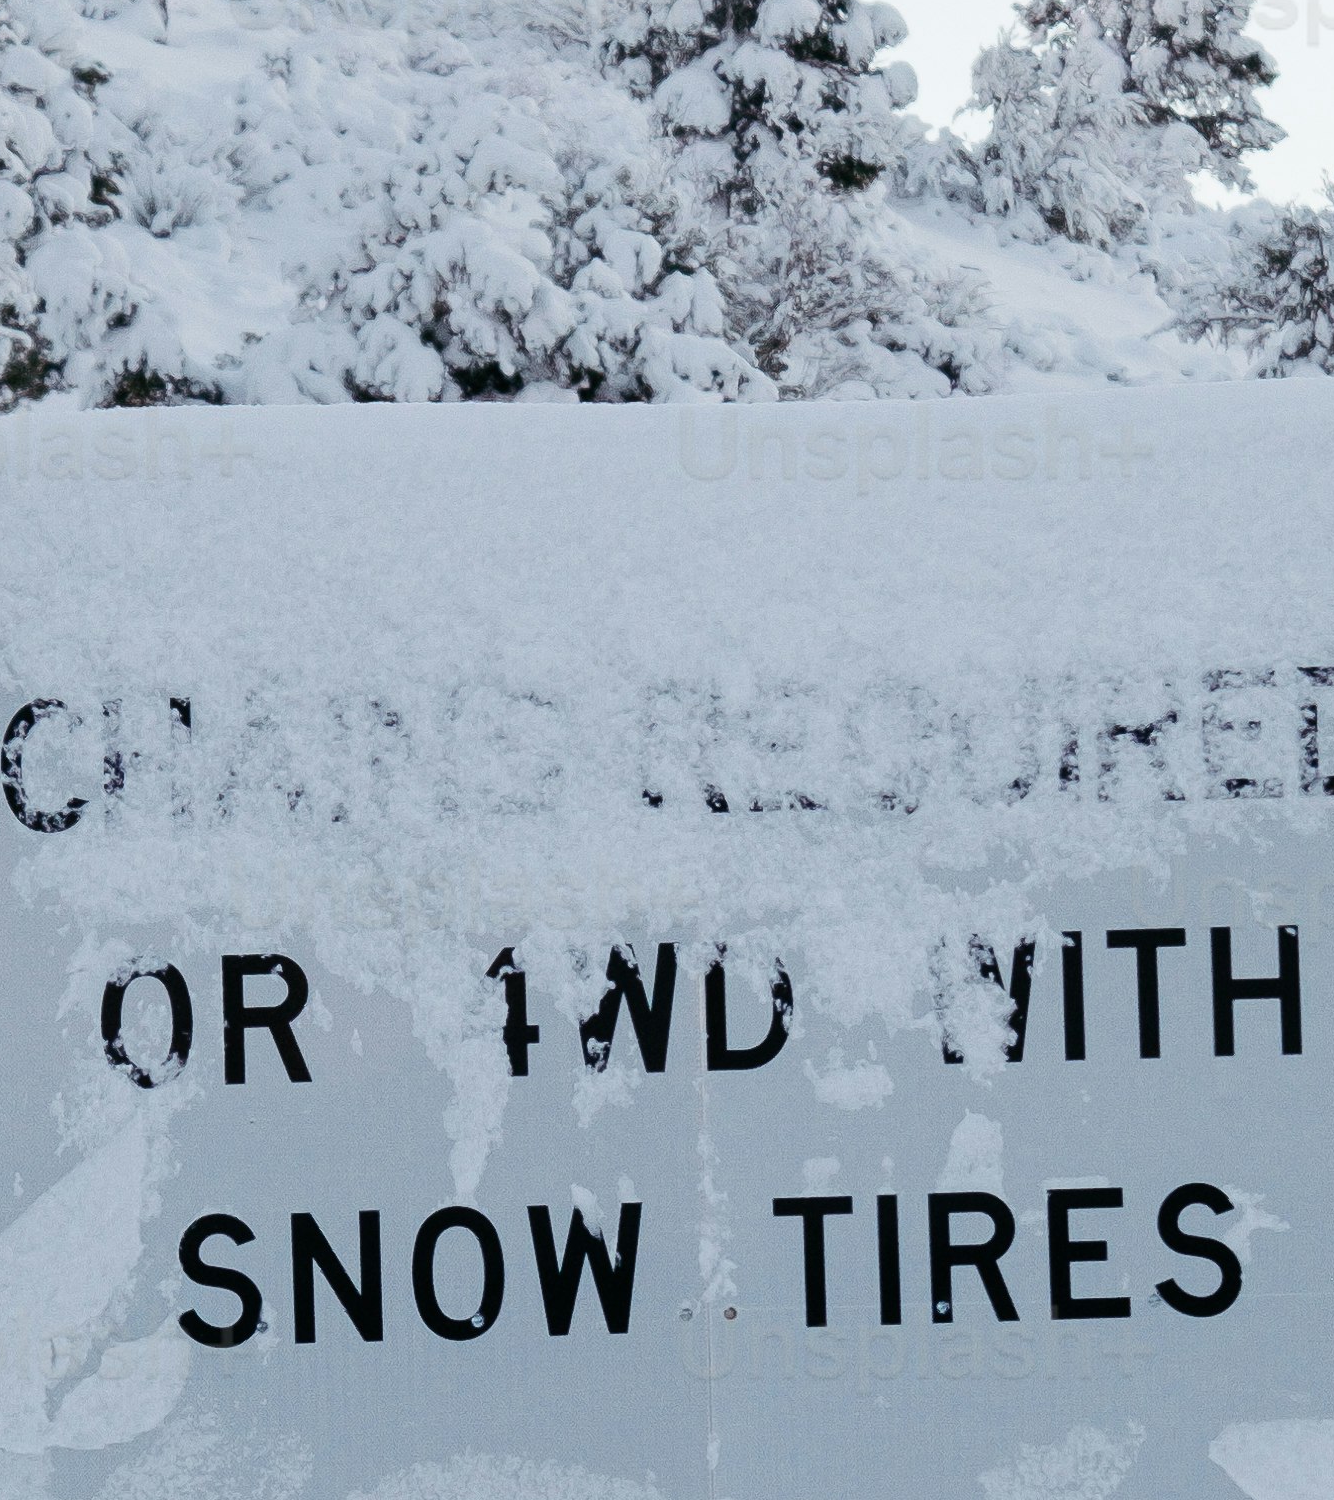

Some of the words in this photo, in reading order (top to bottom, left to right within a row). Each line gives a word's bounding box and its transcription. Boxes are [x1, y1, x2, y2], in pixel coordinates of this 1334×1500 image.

[100, 953, 313, 1090] OR
[176, 1201, 643, 1349] SNOW
[771, 1181, 1243, 1328] TIRES
